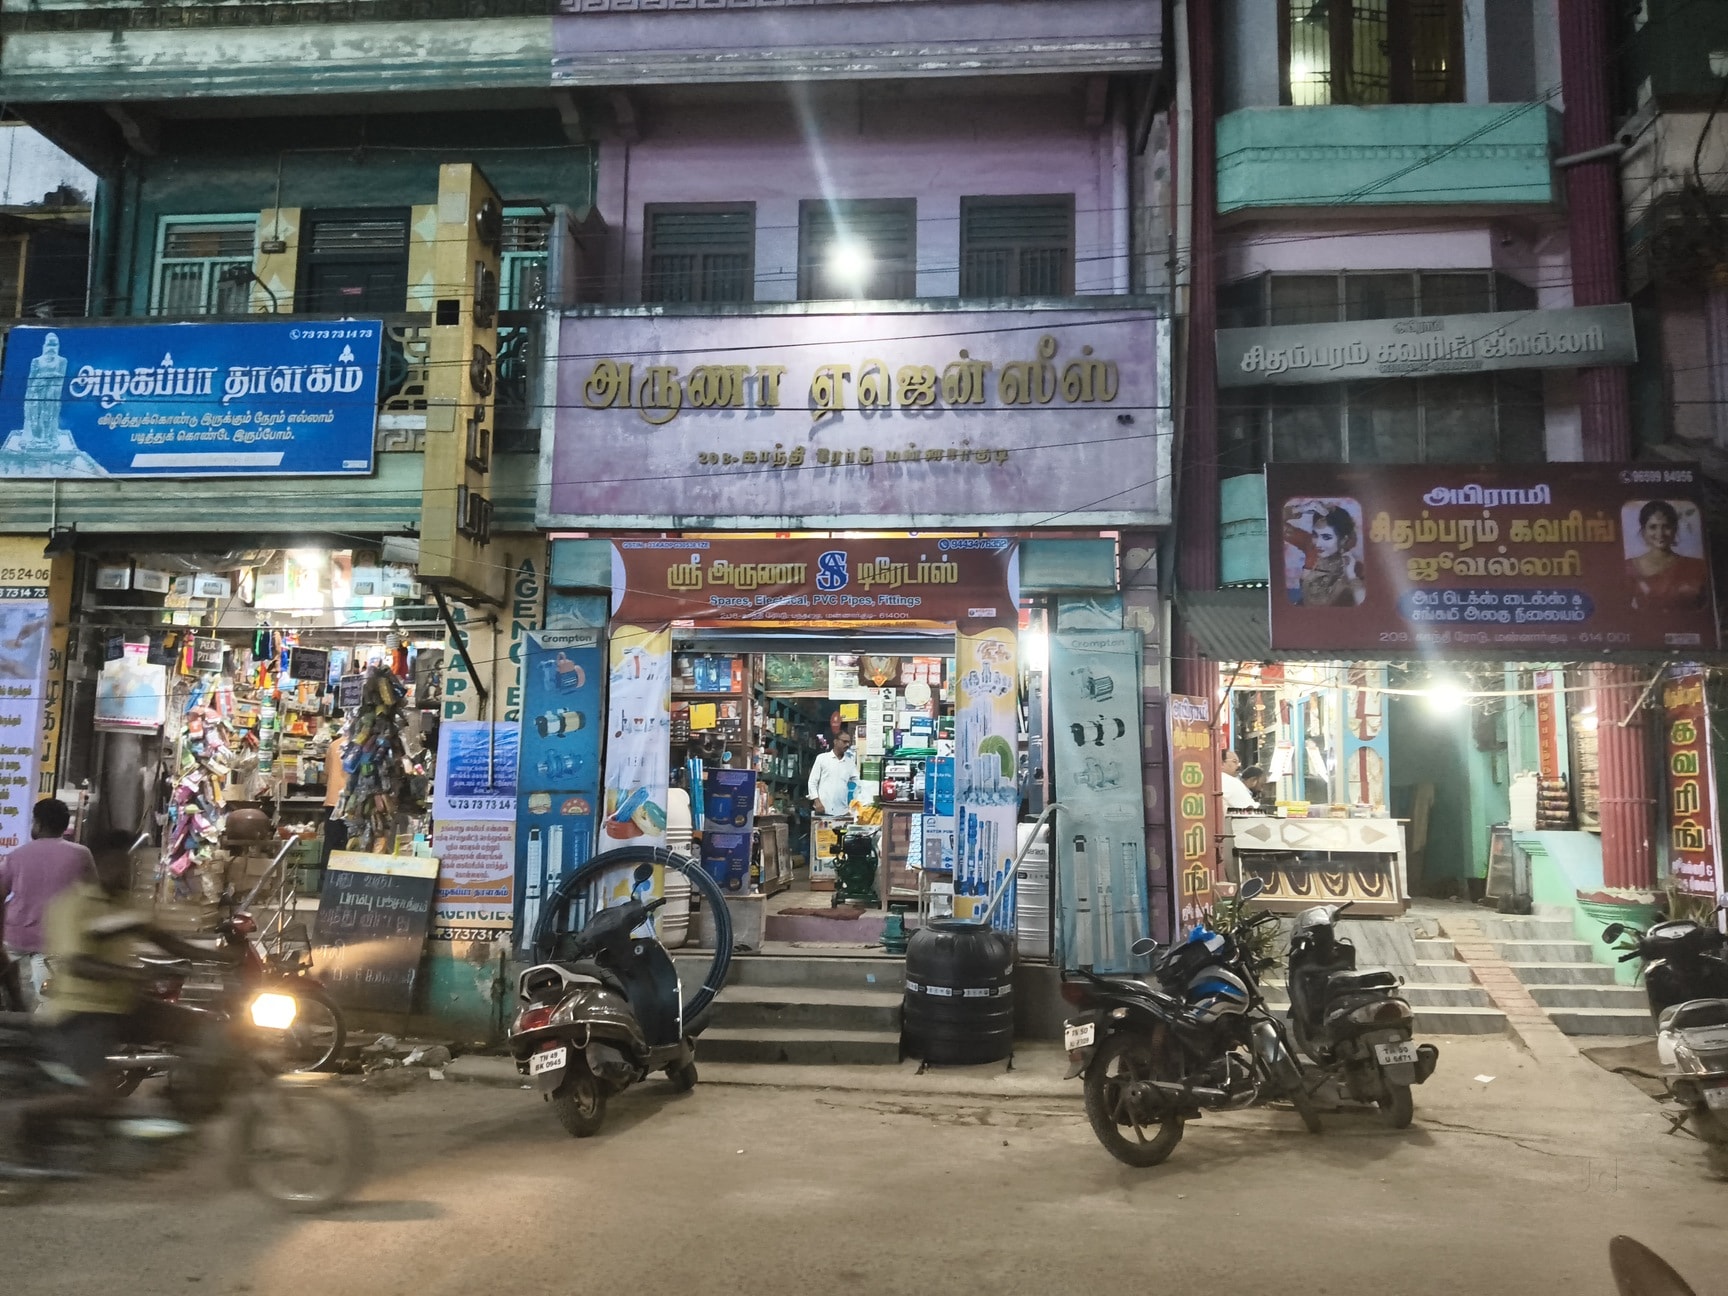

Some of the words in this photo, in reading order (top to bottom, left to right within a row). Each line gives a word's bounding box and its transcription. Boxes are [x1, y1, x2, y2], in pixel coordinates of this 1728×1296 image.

[302, 330, 314, 339] 73
[316, 330, 329, 339] 73
[331, 330, 344, 339] 73
[345, 330, 357, 339] 14
[359, 329, 373, 338] 73
[1240, 340, 1369, 377] சிதம்பரம்
[69, 352, 218, 409] அழகப்பா
[222, 344, 364, 405] தாளகம்
[583, 358, 788, 425] அருணா
[200, 410, 251, 427] இருக்கும்
[254, 410, 285, 425] நேரம்
[287, 409, 335, 424] எல்லாம்
[1423, 484, 1551, 508] அபிராமி
[1369, 510, 1499, 551] சிதம்பரம்
[1509, 510, 1616, 543] கவரிங்
[667, 553, 703, 590] ஸ்ரீ
[708, 559, 807, 590] அருணா
[857, 553, 958, 592] டிரேடர்ஸ்
[710, 594, 752, 608] Spares,
[812, 594, 838, 606] PVC
[839, 594, 875, 608] Pipes,
[878, 594, 921, 608] Fittings
[541, 633, 592, 645] Crompton
[458, 800, 469, 809] 73
[472, 800, 483, 809] 73
[485, 800, 497, 809] 73
[499, 800, 510, 809] 14
[540, 1054, 549, 1062] TN
